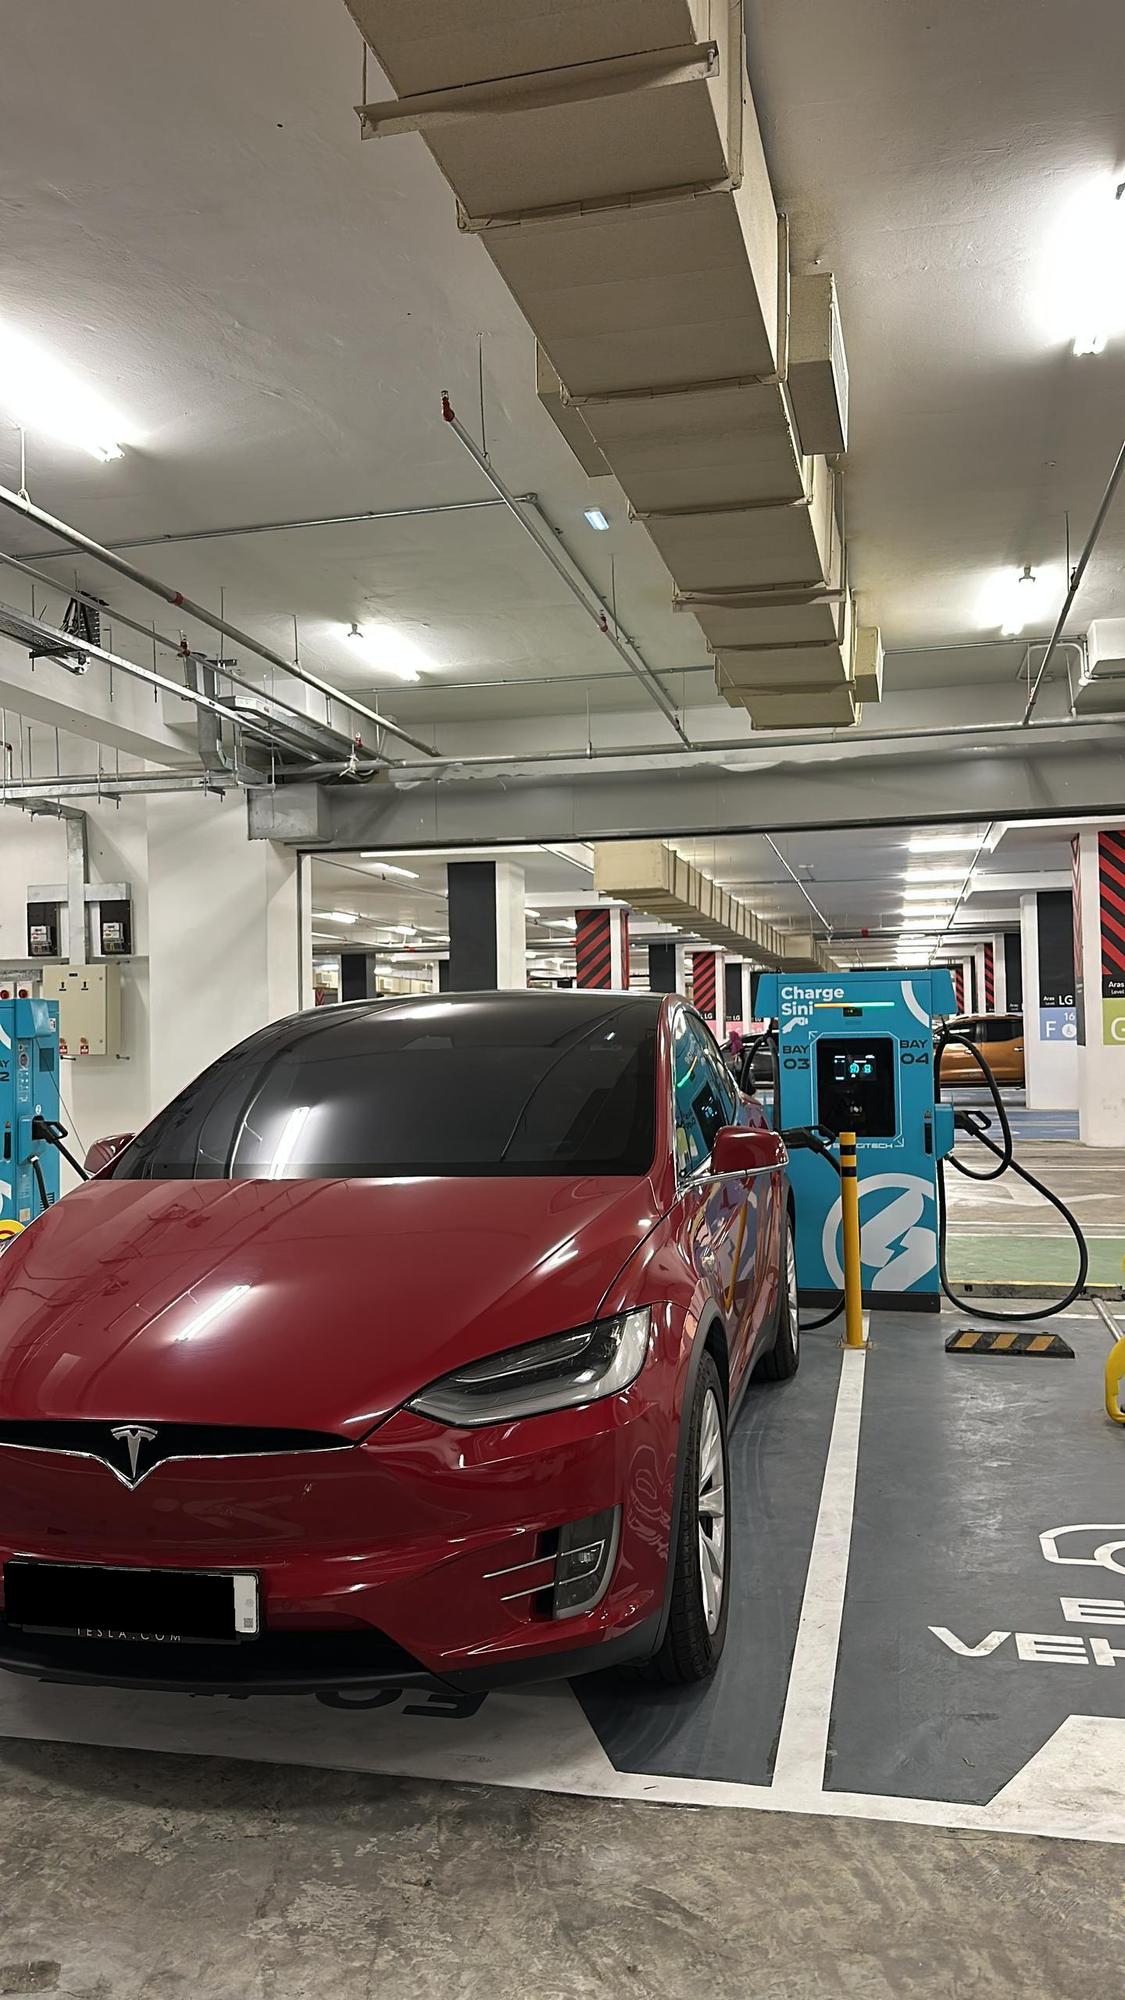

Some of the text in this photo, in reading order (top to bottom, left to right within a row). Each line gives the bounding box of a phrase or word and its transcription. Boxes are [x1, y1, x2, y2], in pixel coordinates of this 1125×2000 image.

[781, 986, 845, 1001] Charge
[1058, 995, 1073, 1006] LG
[781, 1001, 814, 1016] Sini
[1064, 1012, 1076, 1021] 16
[1045, 1021, 1057, 1038] F
[783, 1045, 810, 1054] BAY
[900, 1040, 928, 1049] BAY
[783, 1058, 810, 1070] 03
[900, 1052, 929, 1065] 04
